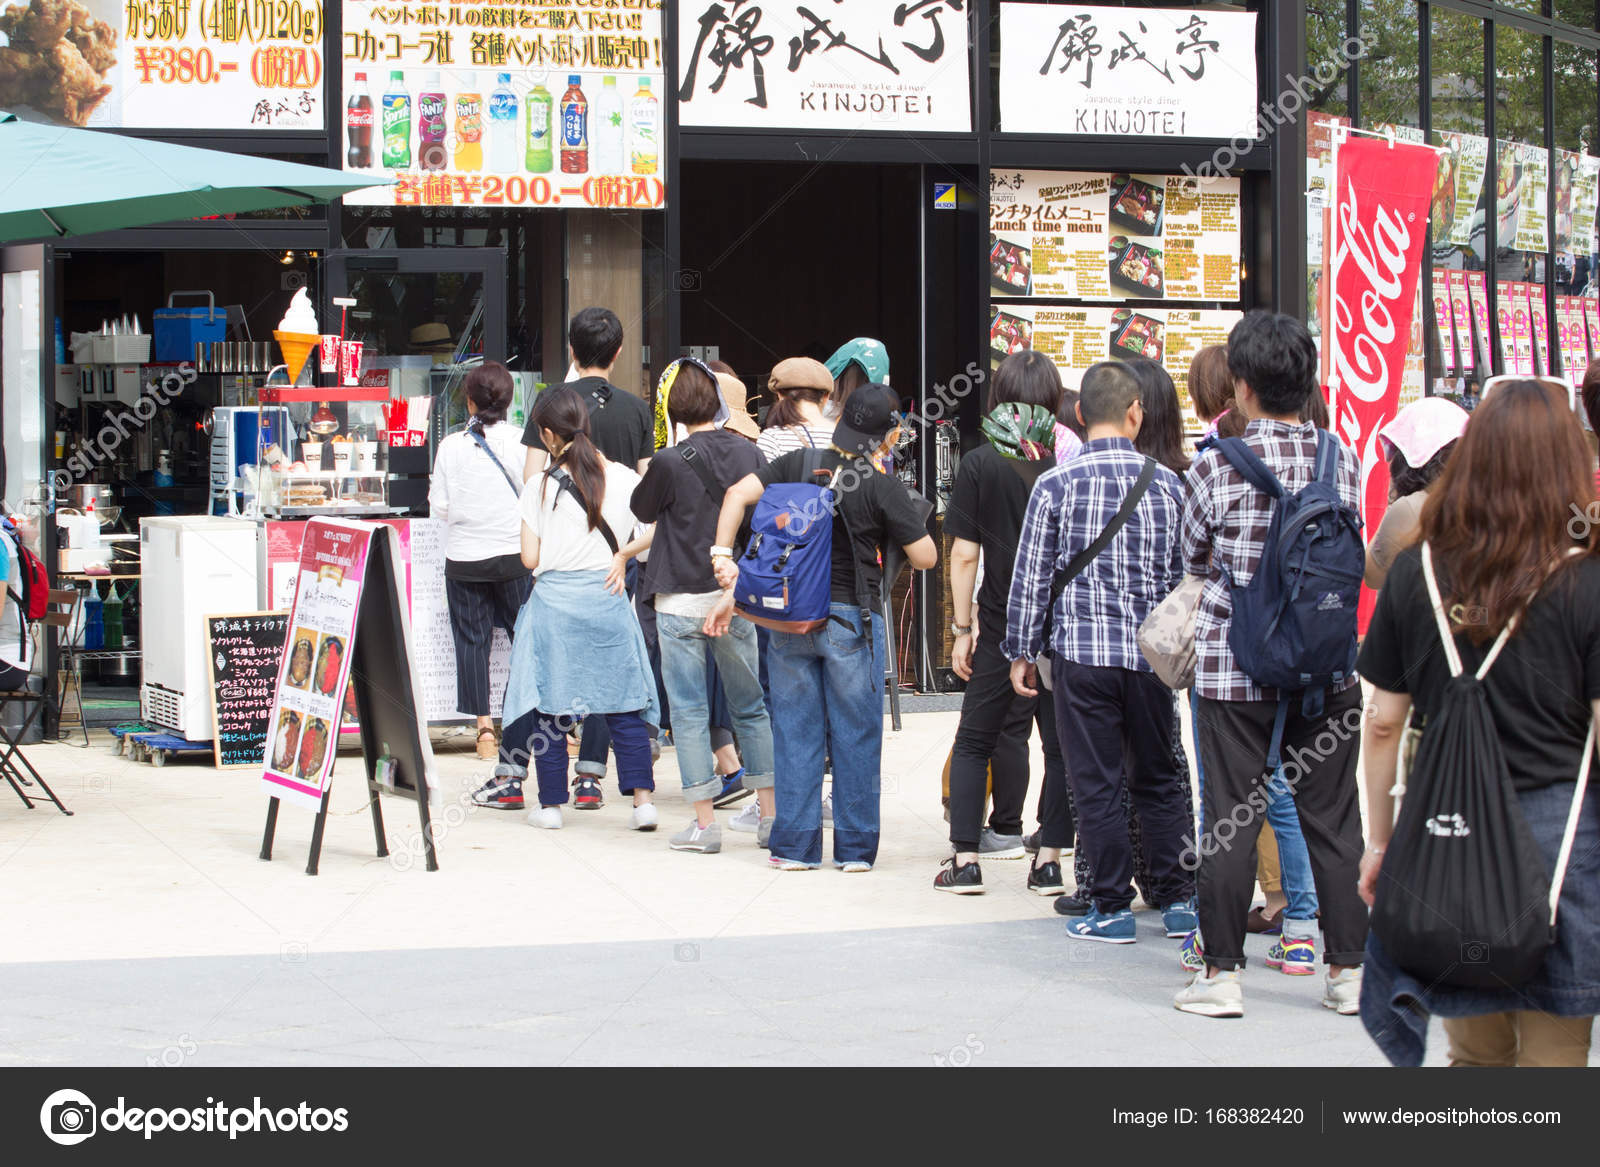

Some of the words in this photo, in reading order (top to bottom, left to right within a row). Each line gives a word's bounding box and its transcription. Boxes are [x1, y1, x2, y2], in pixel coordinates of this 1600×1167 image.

[863, 82, 891, 92] style
[800, 92, 932, 114] KINJOTEI
[1084, 94, 1123, 104] Japanese
[1127, 95, 1153, 105] style
[1075, 108, 1186, 135] KINJOTEI
[1032, 220, 1062, 232] time
[1066, 222, 1103, 233] menu
